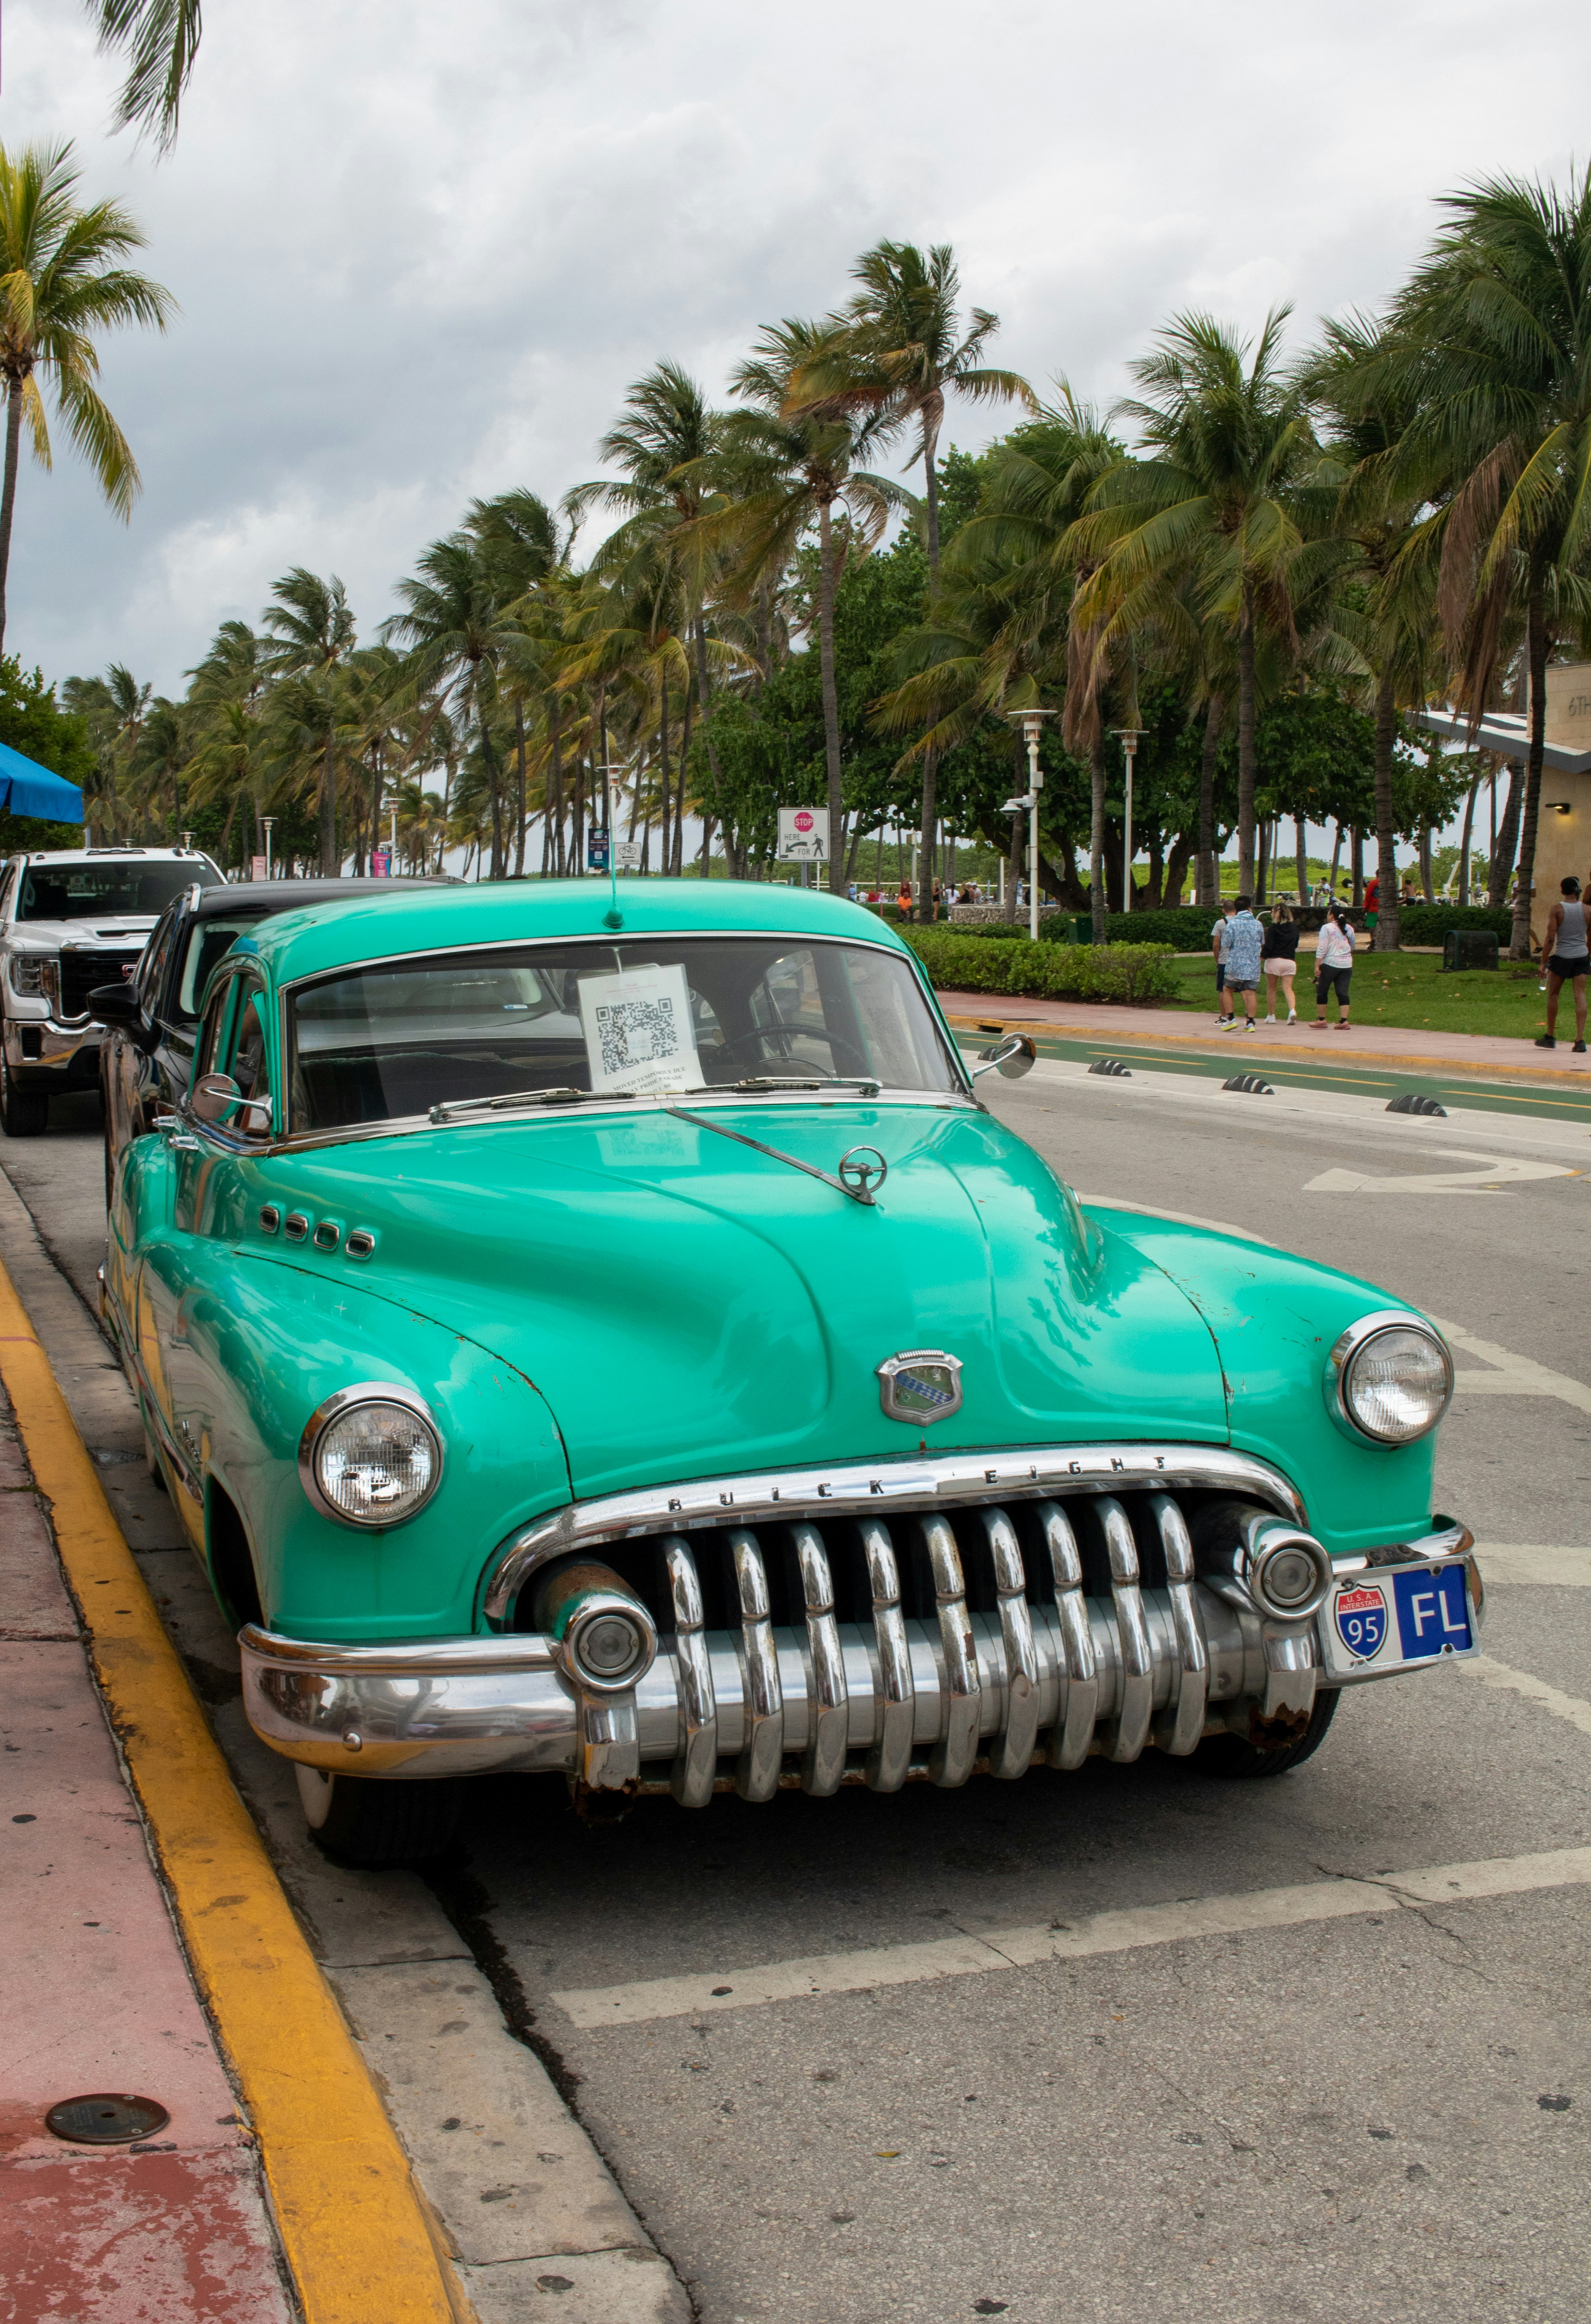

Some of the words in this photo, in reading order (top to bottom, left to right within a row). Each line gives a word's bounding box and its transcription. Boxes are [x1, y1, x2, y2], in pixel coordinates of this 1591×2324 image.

[795, 818, 813, 826] STOP
[613, 1080, 636, 1091] MOVED
[637, 1070, 671, 1082] TEMPORILY
[640, 1078, 658, 1089] PRIDE
[668, 1479, 884, 1512] BUICK
[982, 1456, 1166, 1485] EIGHT
[1340, 1598, 1381, 1611] INTERSTATE
[1411, 1590, 1467, 1636] FL
[1348, 1616, 1379, 1645] 95
